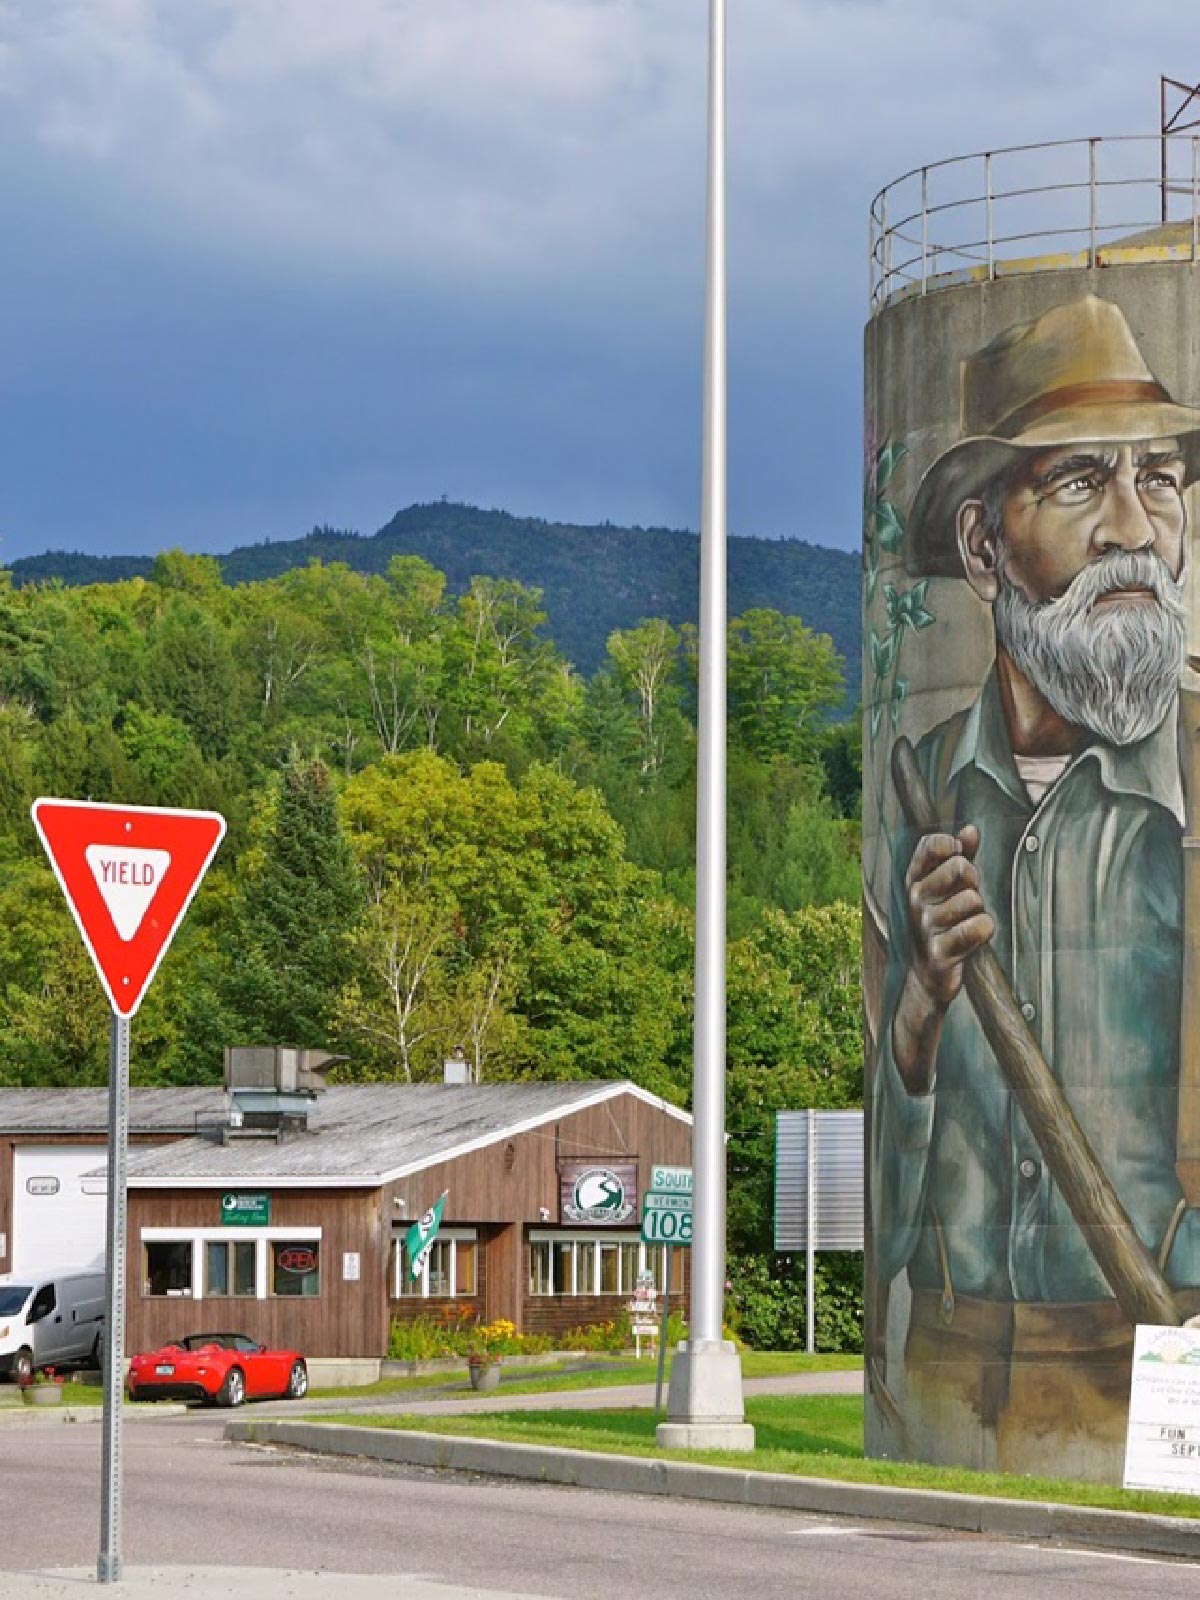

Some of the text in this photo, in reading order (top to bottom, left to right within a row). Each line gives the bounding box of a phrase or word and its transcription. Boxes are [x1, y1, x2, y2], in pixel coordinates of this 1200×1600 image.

[100, 859, 155, 885] YIELD
[654, 1196, 692, 1207] VERMON
[651, 1211, 692, 1239] 108
[279, 1252, 316, 1268] OPEN
[1160, 1427, 1185, 1440] FUN
